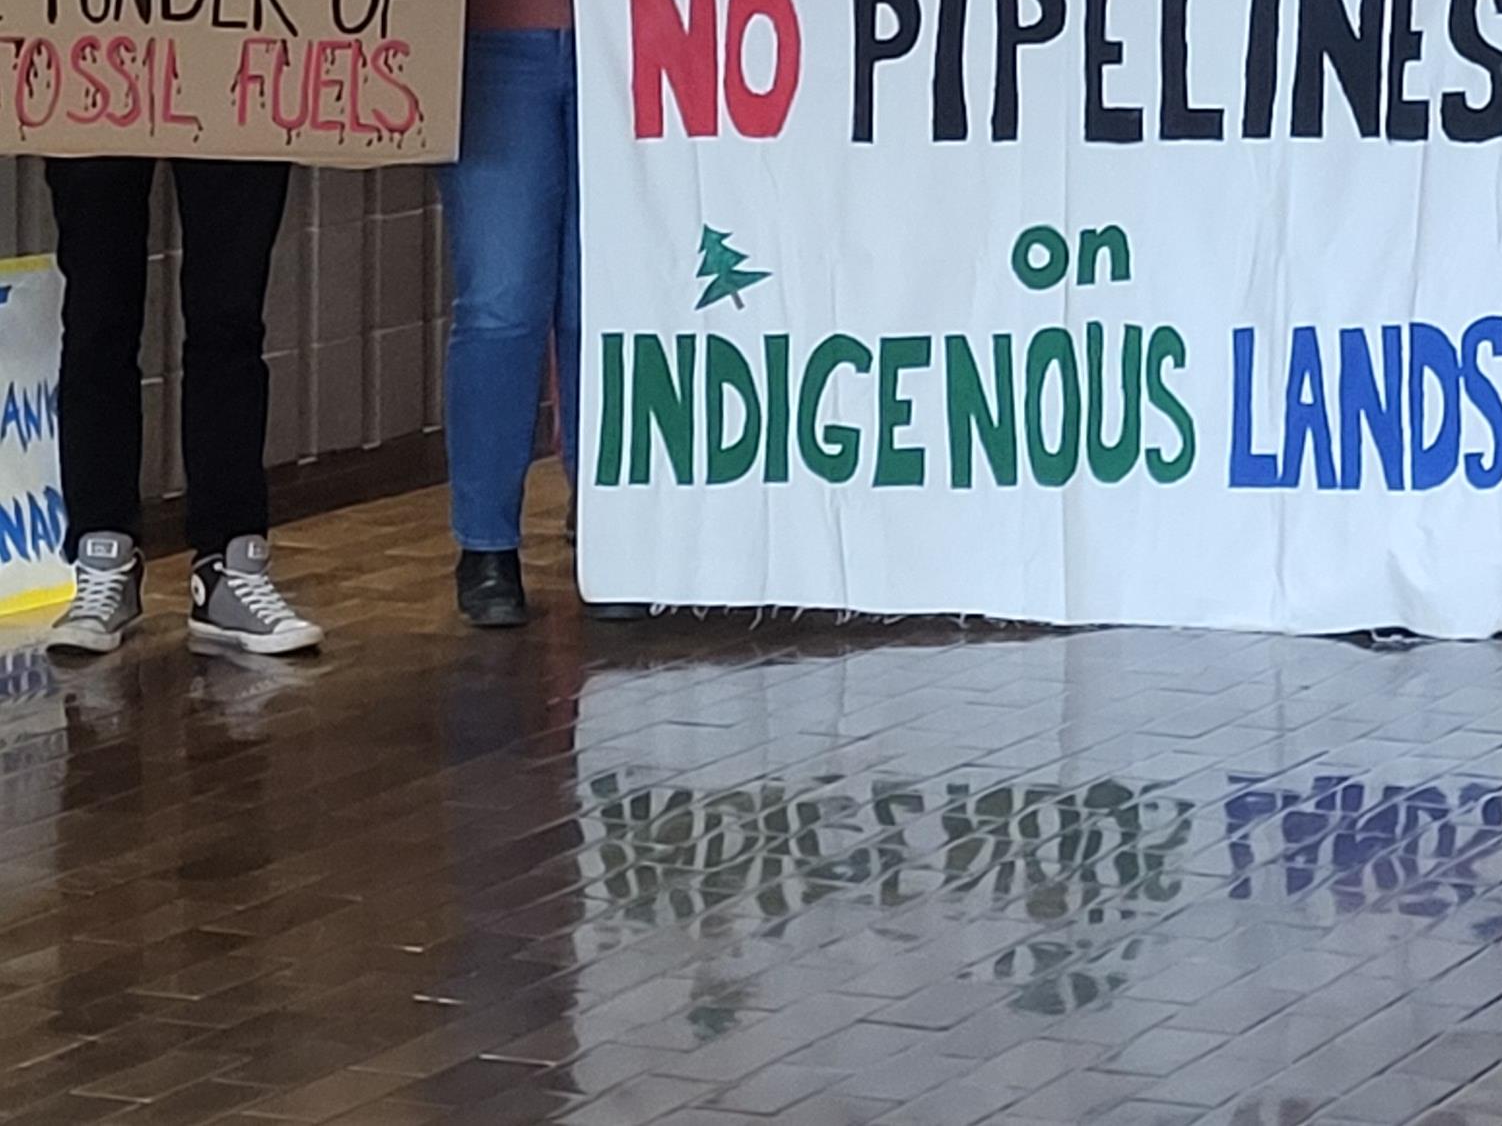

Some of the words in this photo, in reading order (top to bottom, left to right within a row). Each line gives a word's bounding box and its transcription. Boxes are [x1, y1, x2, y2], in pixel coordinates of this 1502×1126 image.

[233, 37, 426, 144] FUELS
[1011, 224, 1132, 292] on
[594, 320, 1197, 491] INDIGENOUS
